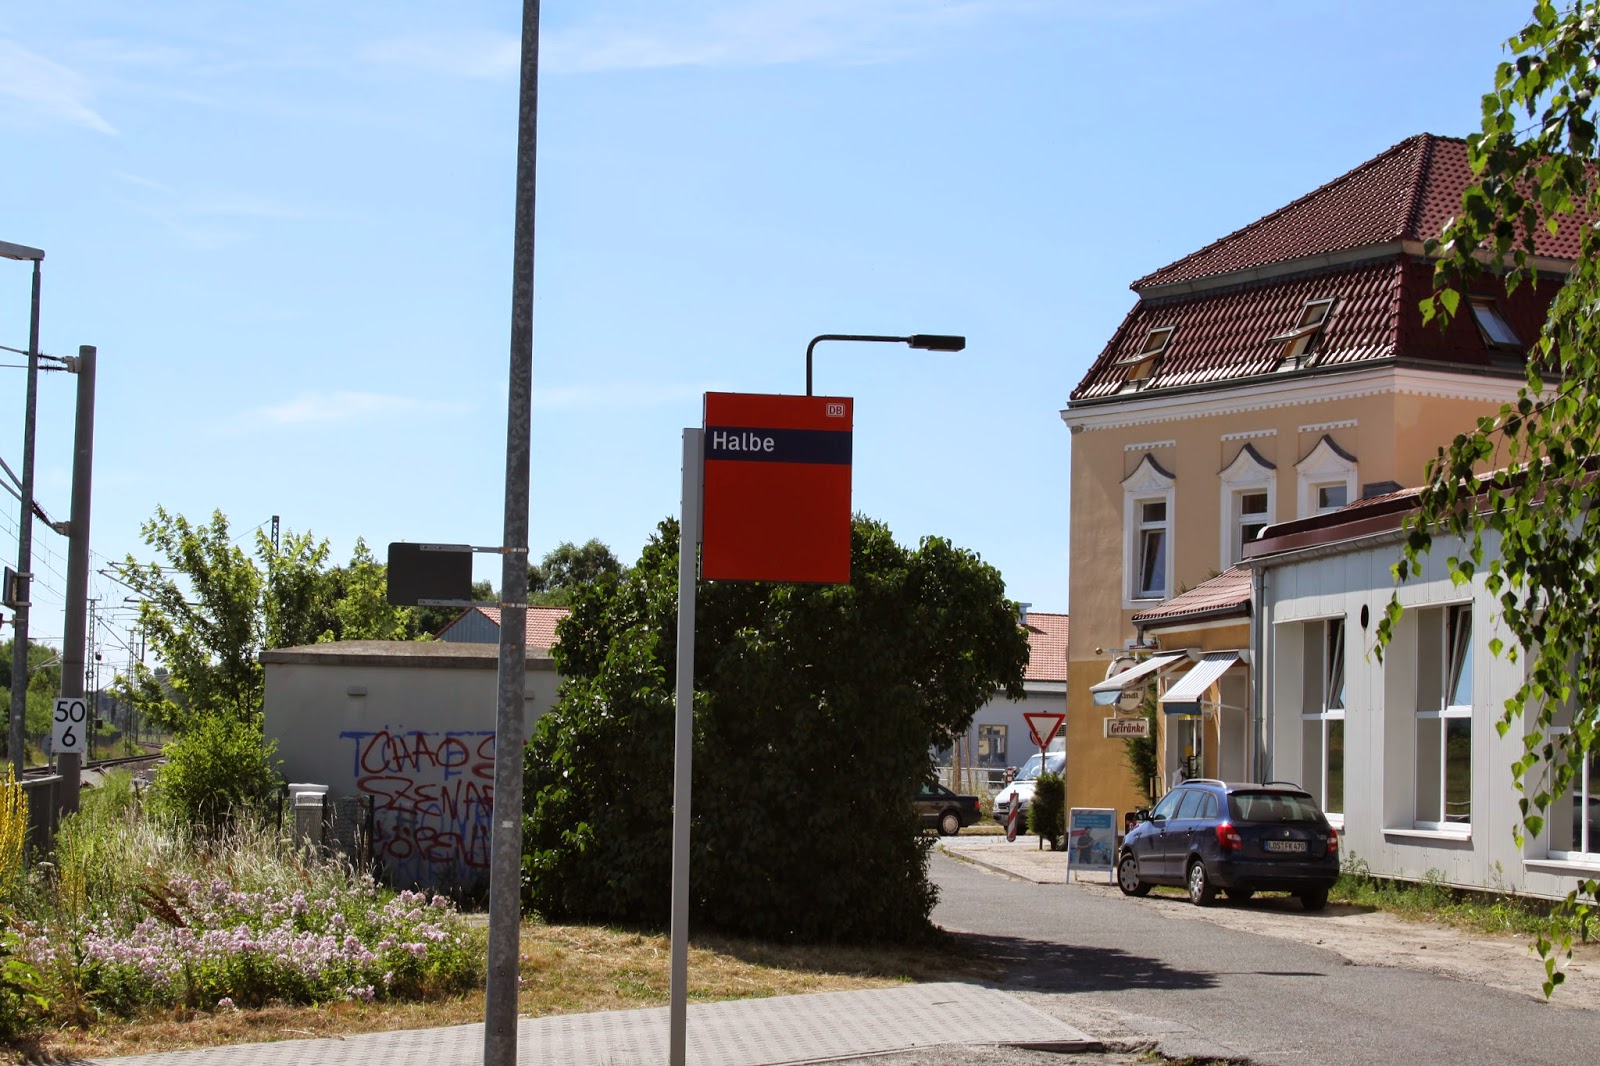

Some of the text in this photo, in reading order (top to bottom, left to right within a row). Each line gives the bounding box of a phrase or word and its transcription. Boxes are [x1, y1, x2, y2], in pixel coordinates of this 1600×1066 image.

[828, 405, 843, 415] DB
[713, 431, 775, 452] Halbe
[54, 701, 86, 723] 50
[62, 725, 77, 747] 6
[1111, 722, 1145, 734] Getränke
